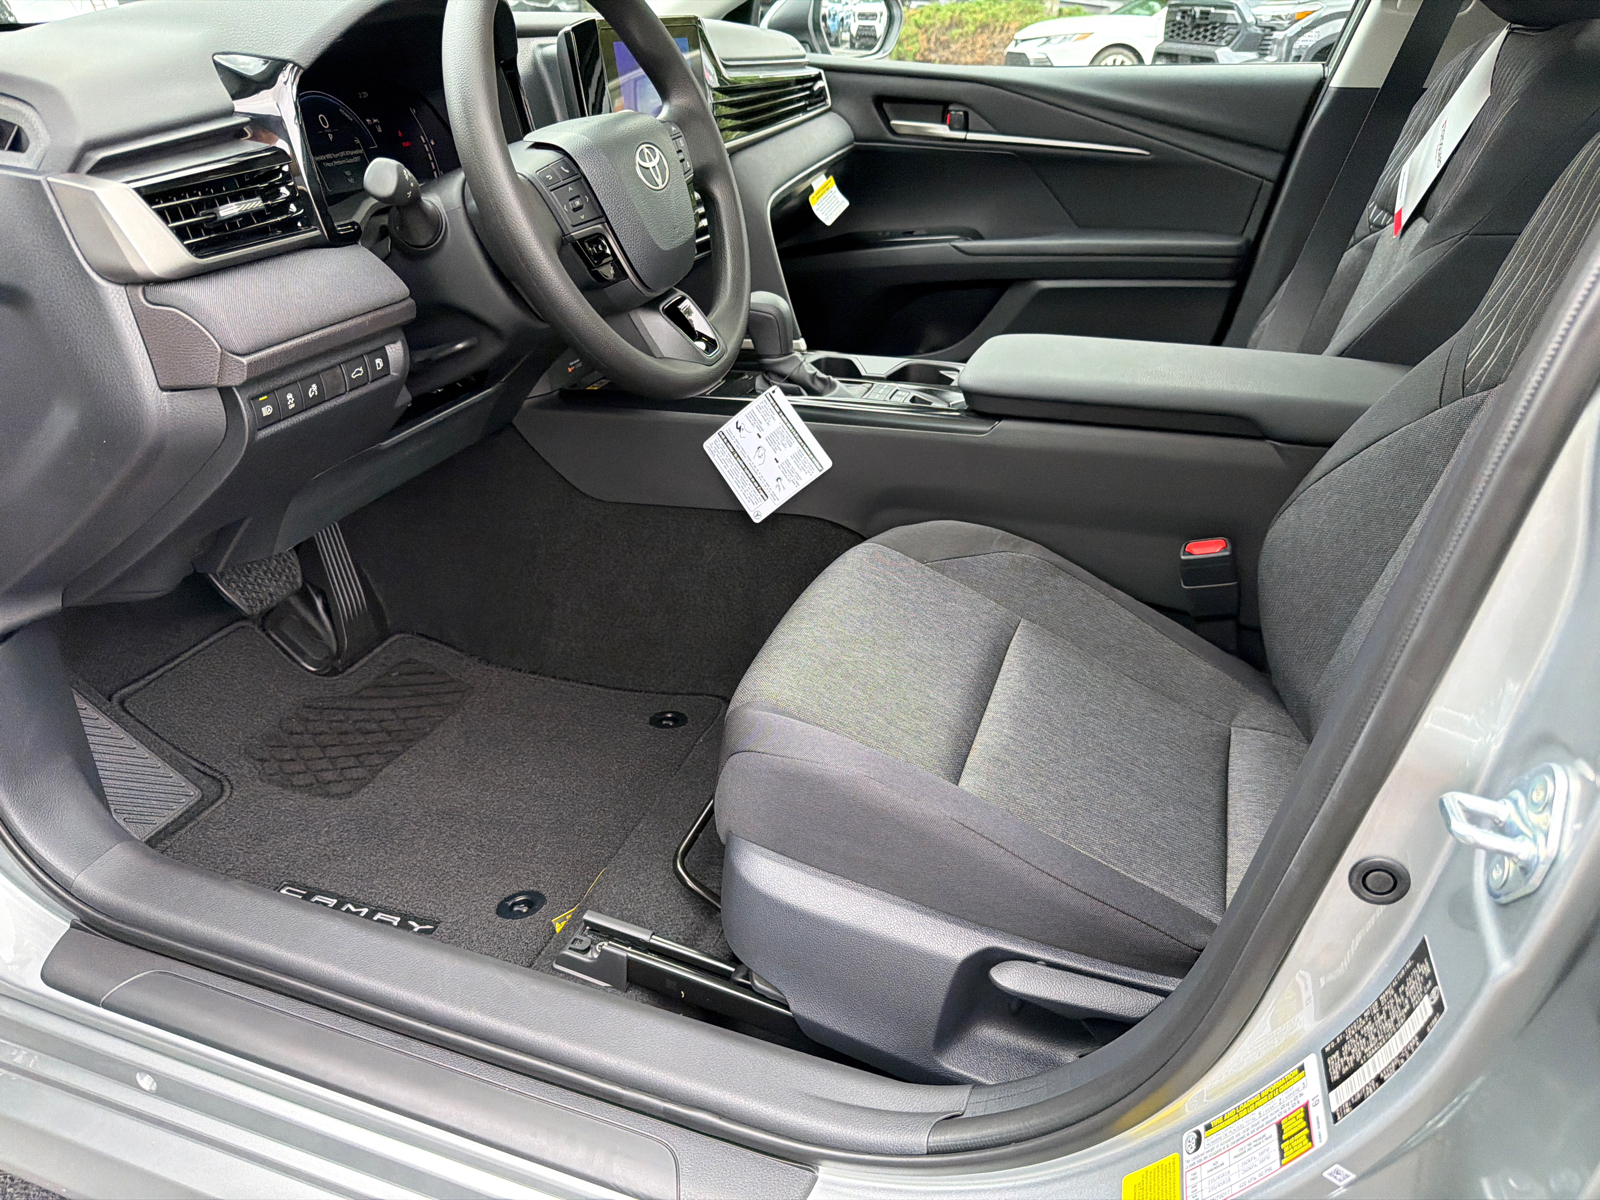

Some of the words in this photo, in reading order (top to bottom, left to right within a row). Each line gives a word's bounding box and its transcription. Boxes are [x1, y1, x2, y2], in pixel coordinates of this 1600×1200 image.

[318, 114, 329, 129] 0
[280, 886, 434, 932] CAMRY
[1210, 1115, 1223, 1128] TIRE
[1223, 1108, 1235, 1120] AND
[1236, 1092, 1260, 1113] LOADING
[1261, 1068, 1298, 1098] INFORMATION
